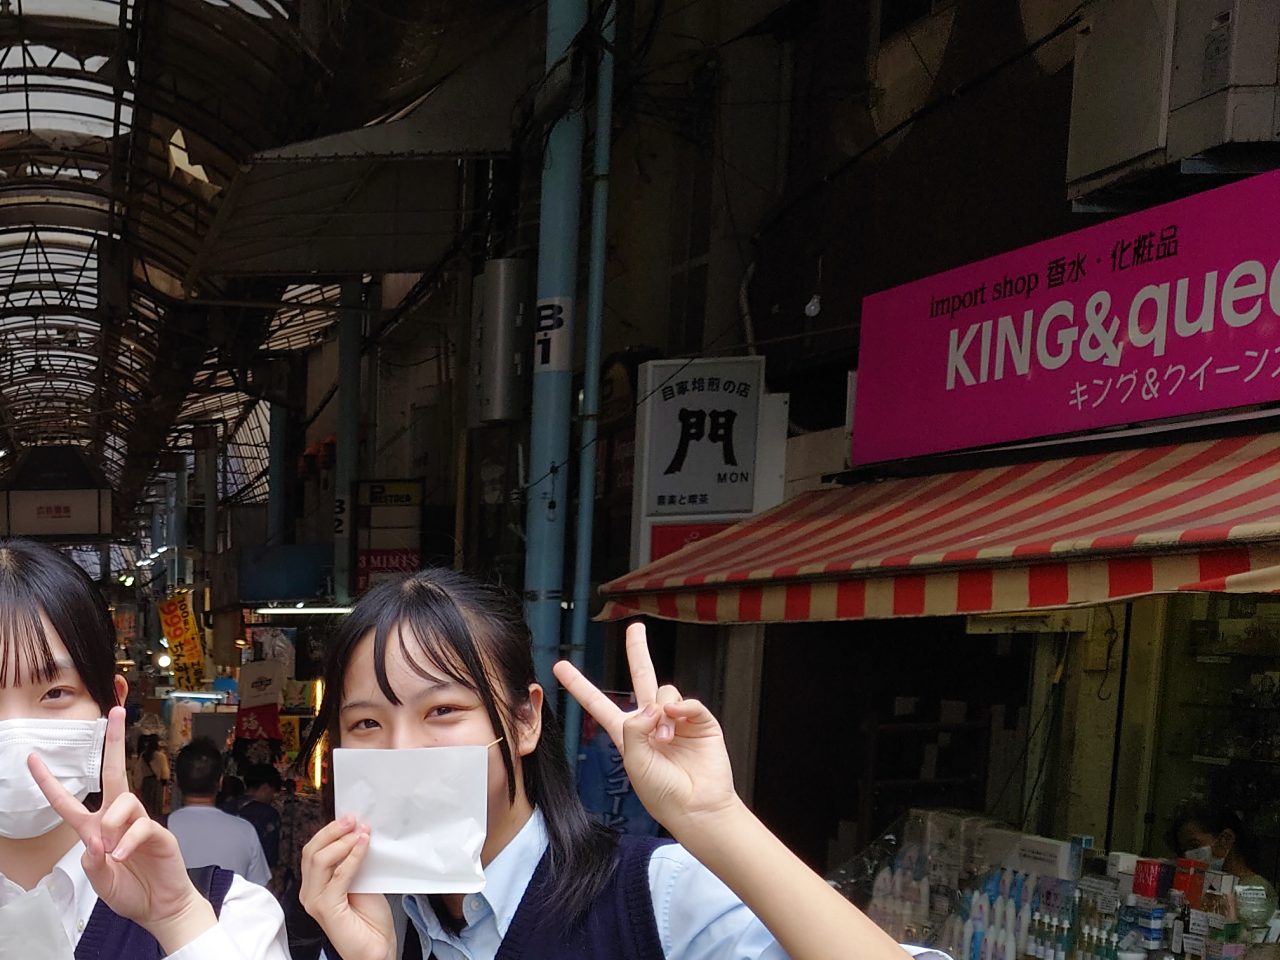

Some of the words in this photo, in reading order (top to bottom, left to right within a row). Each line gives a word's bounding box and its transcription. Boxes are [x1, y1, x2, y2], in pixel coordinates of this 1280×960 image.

[928, 281, 987, 320] import
[992, 271, 1039, 302] shop
[945, 258, 1280, 391] KING&que
[662, 377, 752, 401] 自家焙煎の店
[664, 408, 738, 475] 門
[718, 472, 749, 483] MON
